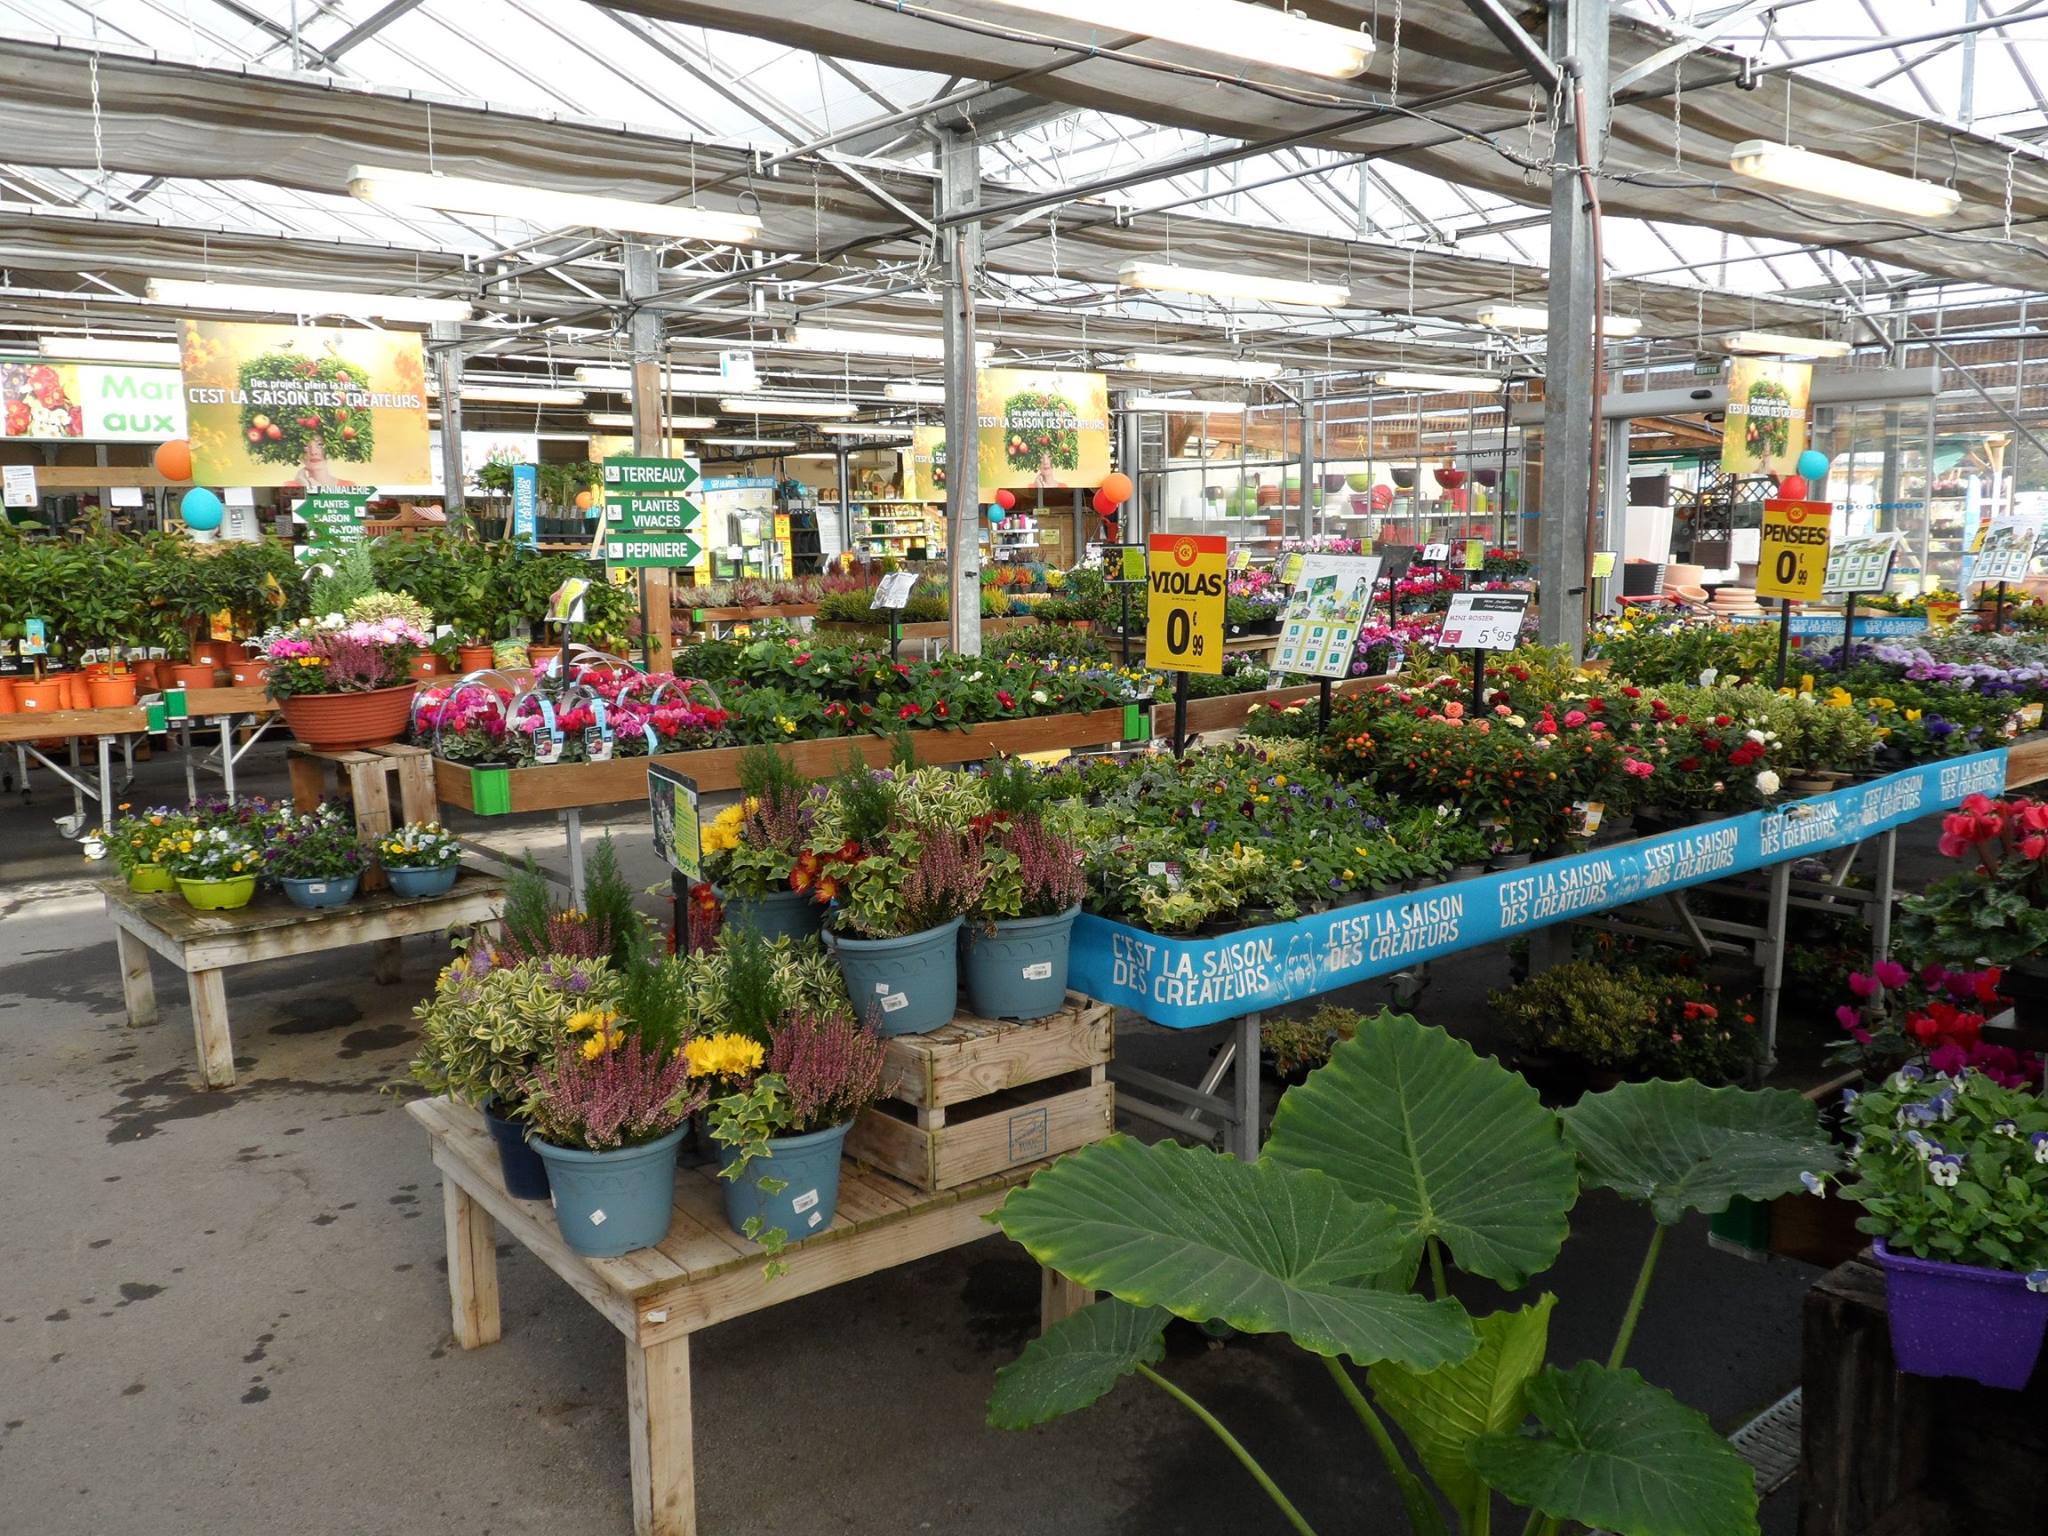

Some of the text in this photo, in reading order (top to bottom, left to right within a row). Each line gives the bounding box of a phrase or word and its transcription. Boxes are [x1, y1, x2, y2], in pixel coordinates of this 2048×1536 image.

[102, 374, 177, 399] Mar
[251, 378, 267, 388] Des
[270, 379, 301, 392] projets
[304, 380, 327, 392] plein
[189, 387, 225, 404] C'EST
[231, 388, 248, 404] LA
[252, 389, 308, 406] SAISON
[314, 391, 341, 407] DES
[103, 413, 176, 432] aux
[1000, 417, 1009, 428] LA
[1012, 417, 1044, 429] SAISON
[1047, 418, 1060, 429] DES
[622, 467, 686, 482] TERREAUX
[313, 500, 350, 508] PLANTES
[631, 500, 680, 511] PLANTES
[632, 515, 681, 527] VIVACES
[1764, 524, 1826, 545] PENSEES
[626, 542, 688, 558] PEPINIERE
[1776, 550, 1797, 584] 0
[1797, 570, 1808, 585] 99
[1151, 571, 1222, 596] VIOLAS
[1167, 608, 1190, 655] 0
[1193, 634, 1203, 656] 99
[1478, 629, 1489, 644] 5
[1496, 631, 1512, 642] 95
[1645, 827, 1738, 870] C'EST LA SAISON
[1500, 860, 1612, 907] C'EST LA SAISON
[1646, 865, 1671, 888] DES
[1329, 893, 1463, 948] C'EST LA SAISON
[1501, 902, 1528, 928] DES
[1112, 932, 1273, 979] C'EST LA SAISON
[1330, 942, 1363, 972] DES
[1113, 959, 1147, 995] DES
